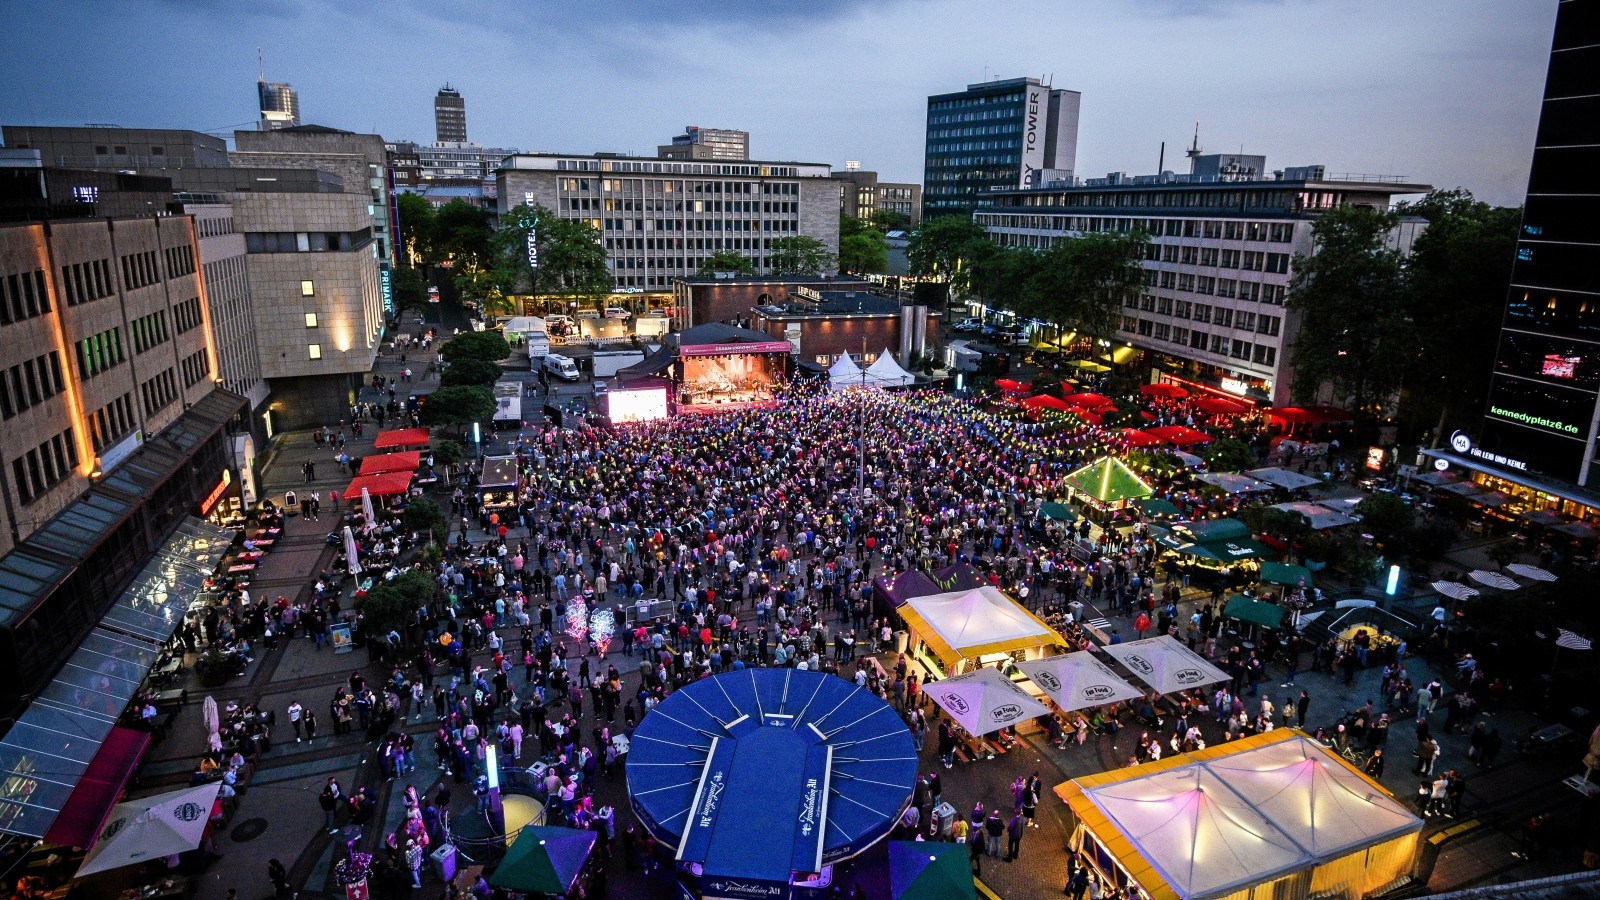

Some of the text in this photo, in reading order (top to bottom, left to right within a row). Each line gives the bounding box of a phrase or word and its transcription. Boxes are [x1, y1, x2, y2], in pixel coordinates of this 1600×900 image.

[1026, 92, 1040, 154] TOWER
[381, 270, 392, 312] PRIMARK
[1491, 406, 1578, 434] kennedyplatz6.de
[1455, 438, 1467, 449] MA
[1470, 447, 1482, 458] FÜR
[1482, 450, 1495, 461] LEIB
[1494, 454, 1507, 465] UND
[768, 886, 780, 895] Alt
